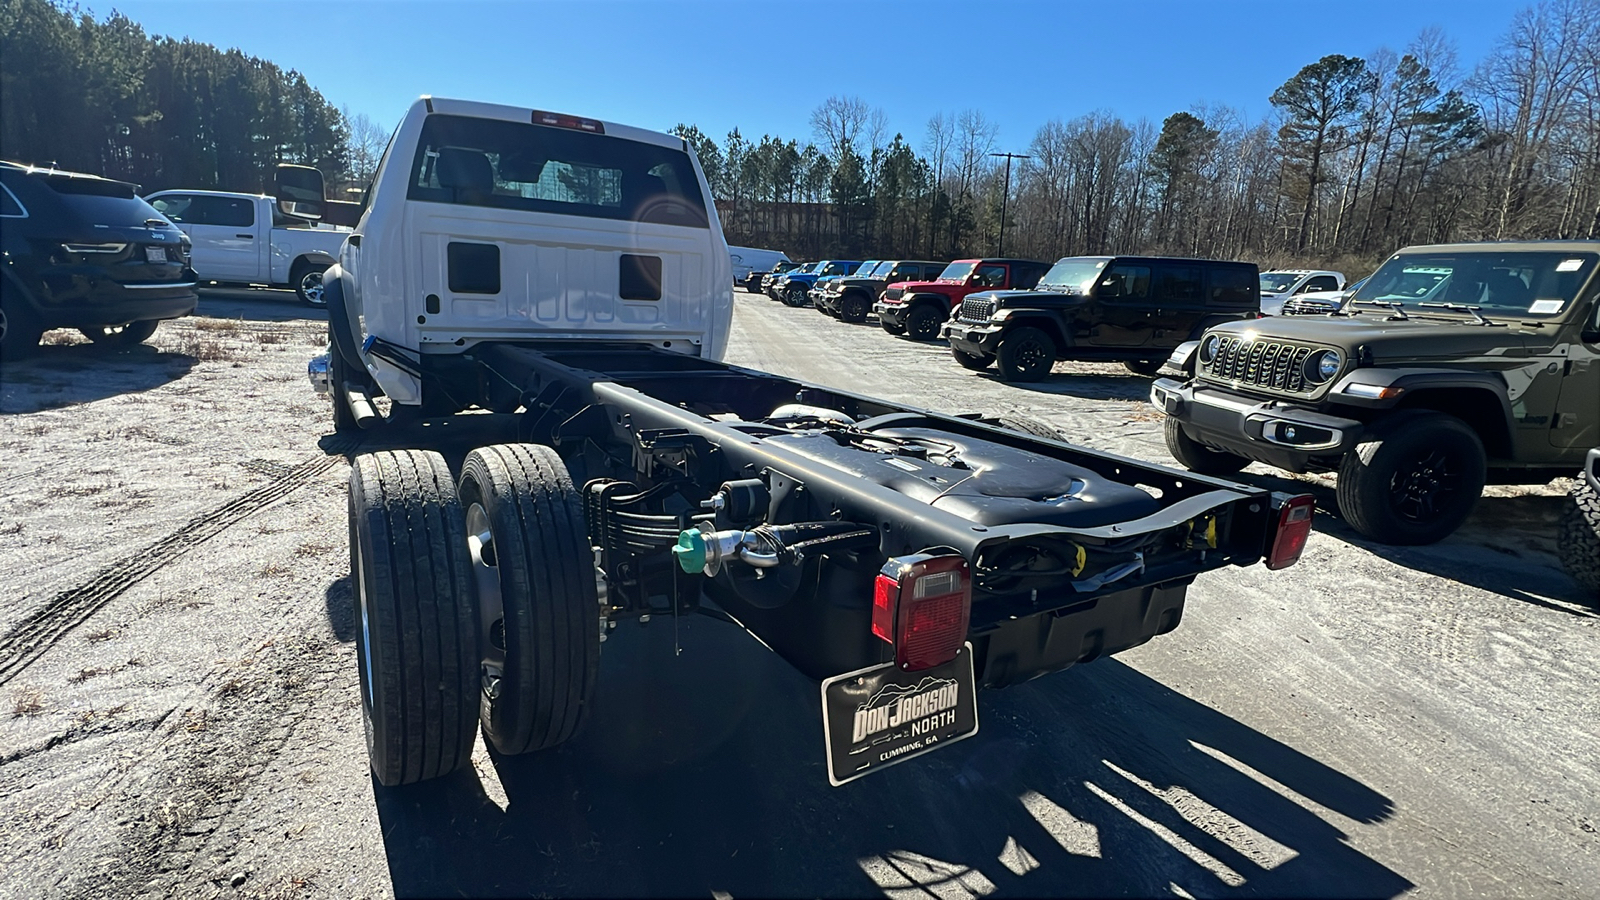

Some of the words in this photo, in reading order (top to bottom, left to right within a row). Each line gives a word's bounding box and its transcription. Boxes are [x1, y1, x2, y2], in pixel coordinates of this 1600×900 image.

[853, 704, 890, 744] DON
[890, 683, 958, 728] JACKSON
[912, 709, 955, 737] NORTH
[880, 740, 924, 761] CUMMING,
[925, 735, 938, 744] GA
